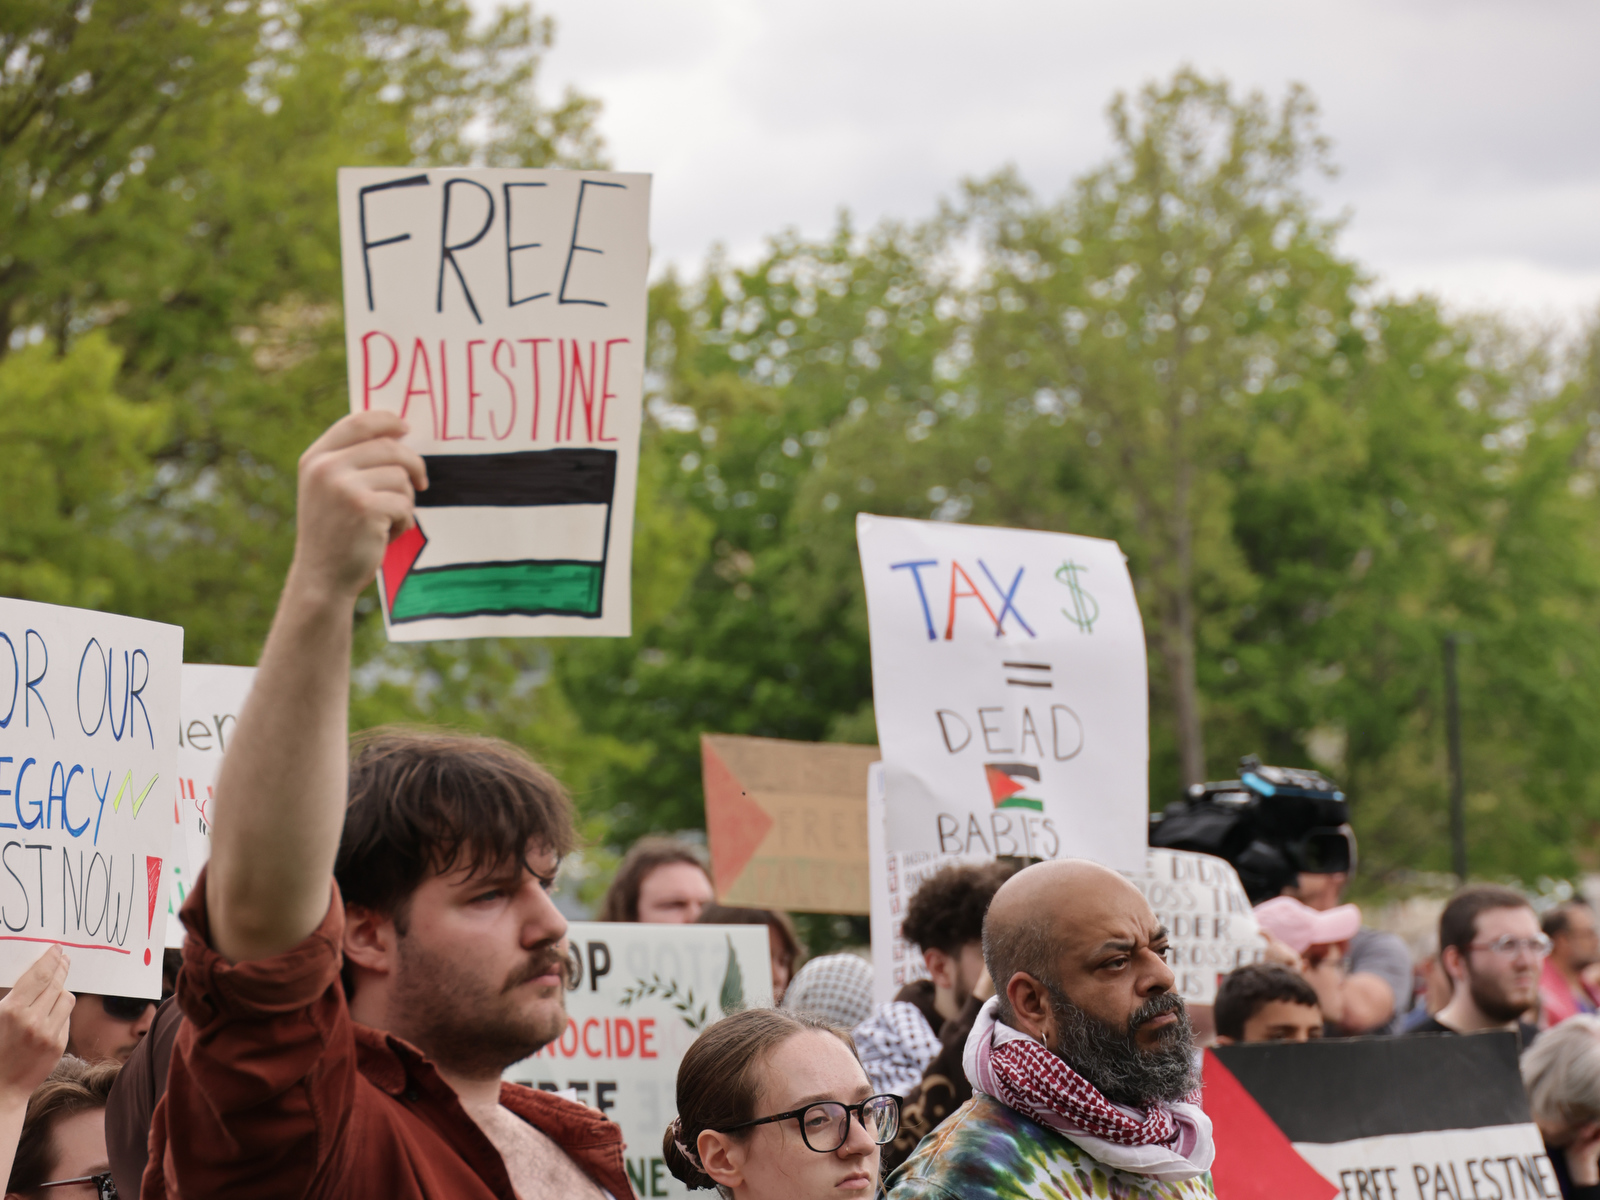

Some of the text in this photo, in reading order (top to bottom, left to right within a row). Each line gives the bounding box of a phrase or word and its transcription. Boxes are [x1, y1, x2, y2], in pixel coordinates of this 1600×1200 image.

[358, 174, 628, 324] FREE
[361, 331, 631, 443] PALESTINE
[890, 559, 1099, 641] TAX $
[77, 637, 154, 750] OUR
[936, 704, 1084, 761] DEAD
[0, 841, 52, 932] ST
[526, 1017, 658, 1060] OCIDE
